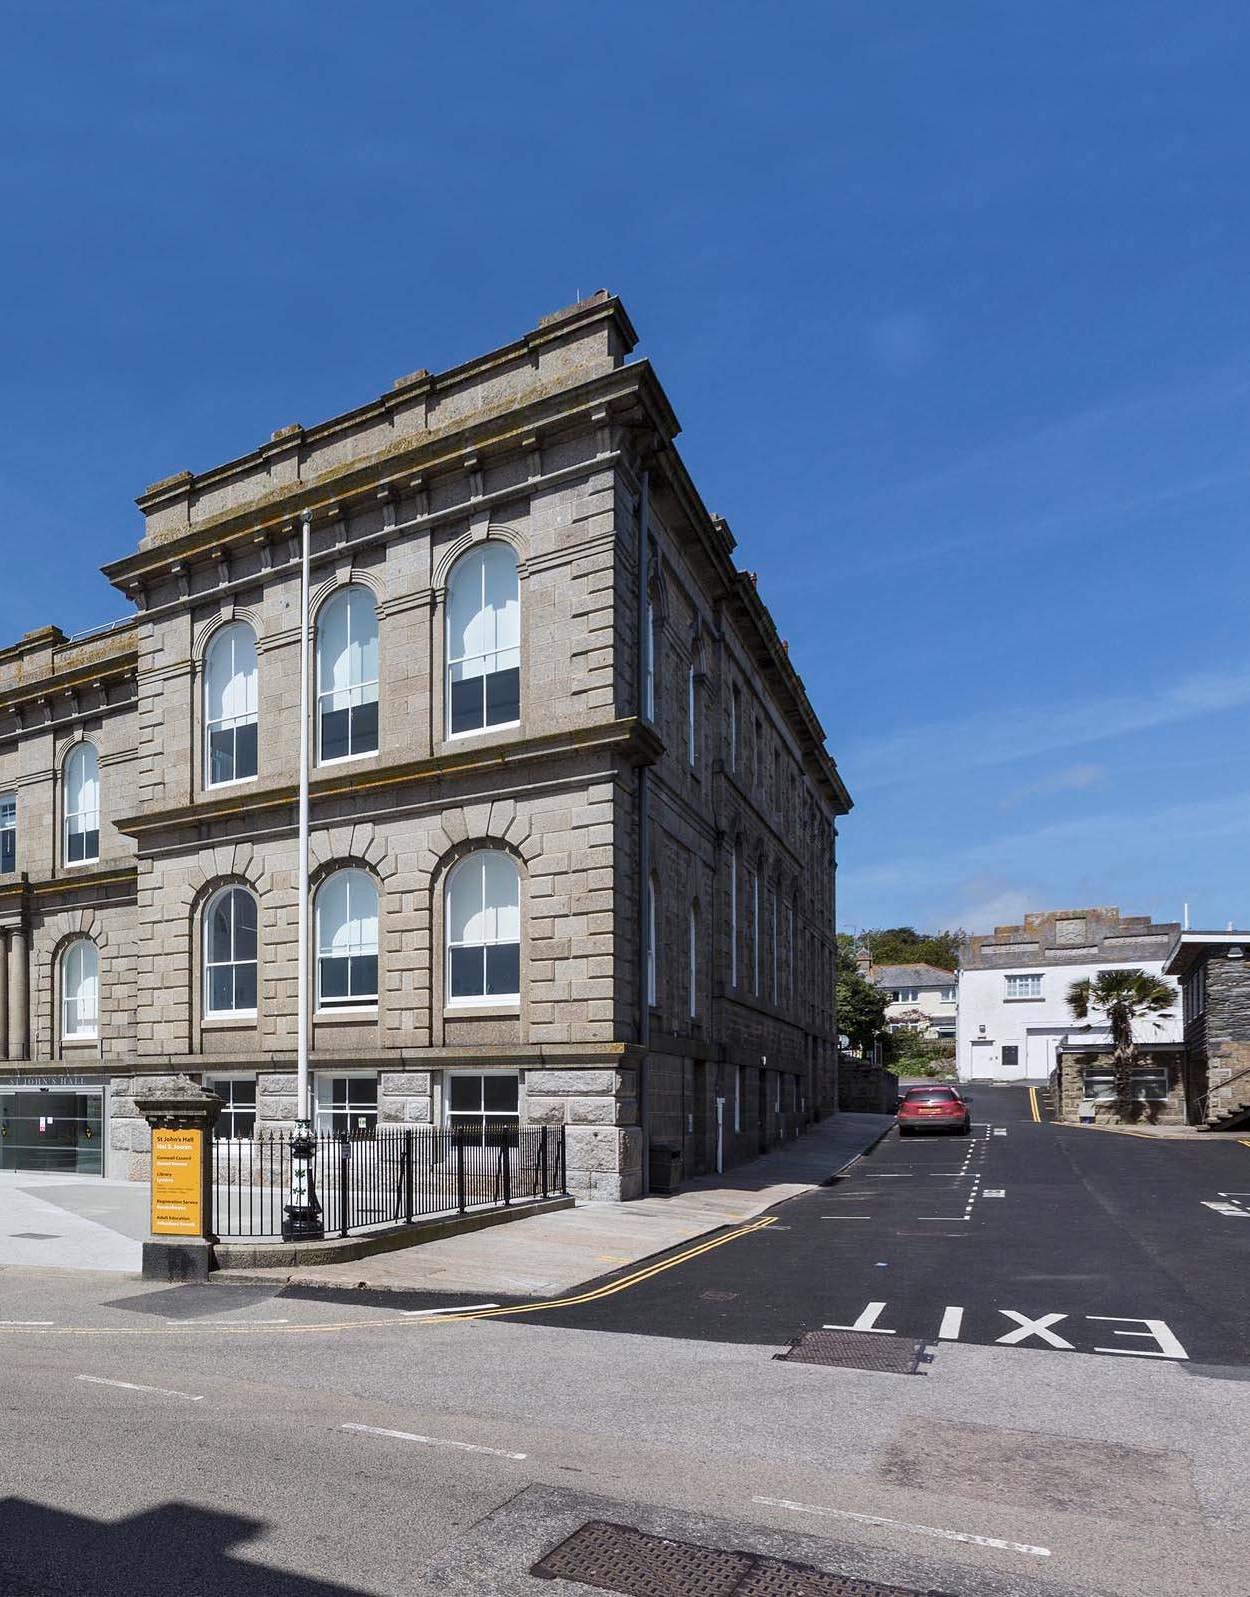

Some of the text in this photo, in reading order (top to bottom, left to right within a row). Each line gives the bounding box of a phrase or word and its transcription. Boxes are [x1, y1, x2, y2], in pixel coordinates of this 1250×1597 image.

[8, 1077, 86, 1086] ST JOHN'S HALL
[822, 1302, 1190, 1360] EXIT
